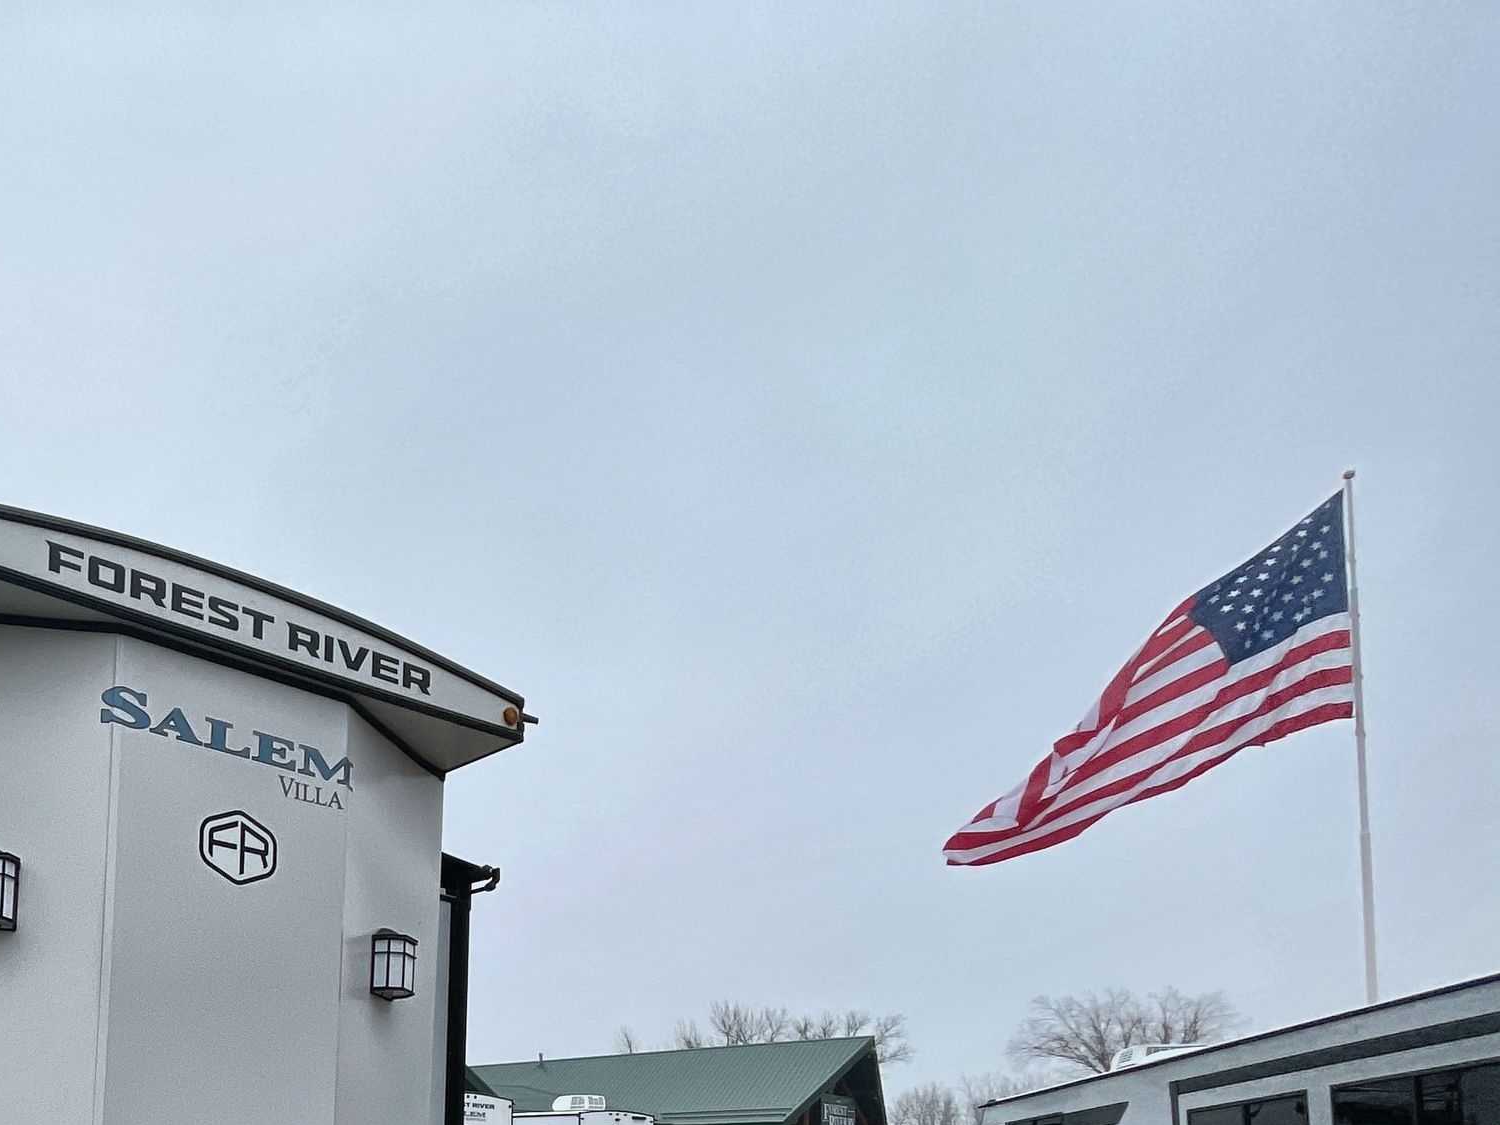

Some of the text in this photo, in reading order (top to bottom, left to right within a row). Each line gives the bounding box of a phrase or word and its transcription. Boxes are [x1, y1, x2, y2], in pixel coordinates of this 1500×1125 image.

[45, 539, 432, 695] FOREST RIVER
[100, 685, 354, 792] SALEM
[278, 775, 345, 811] VILLA
[206, 818, 271, 877] FR
